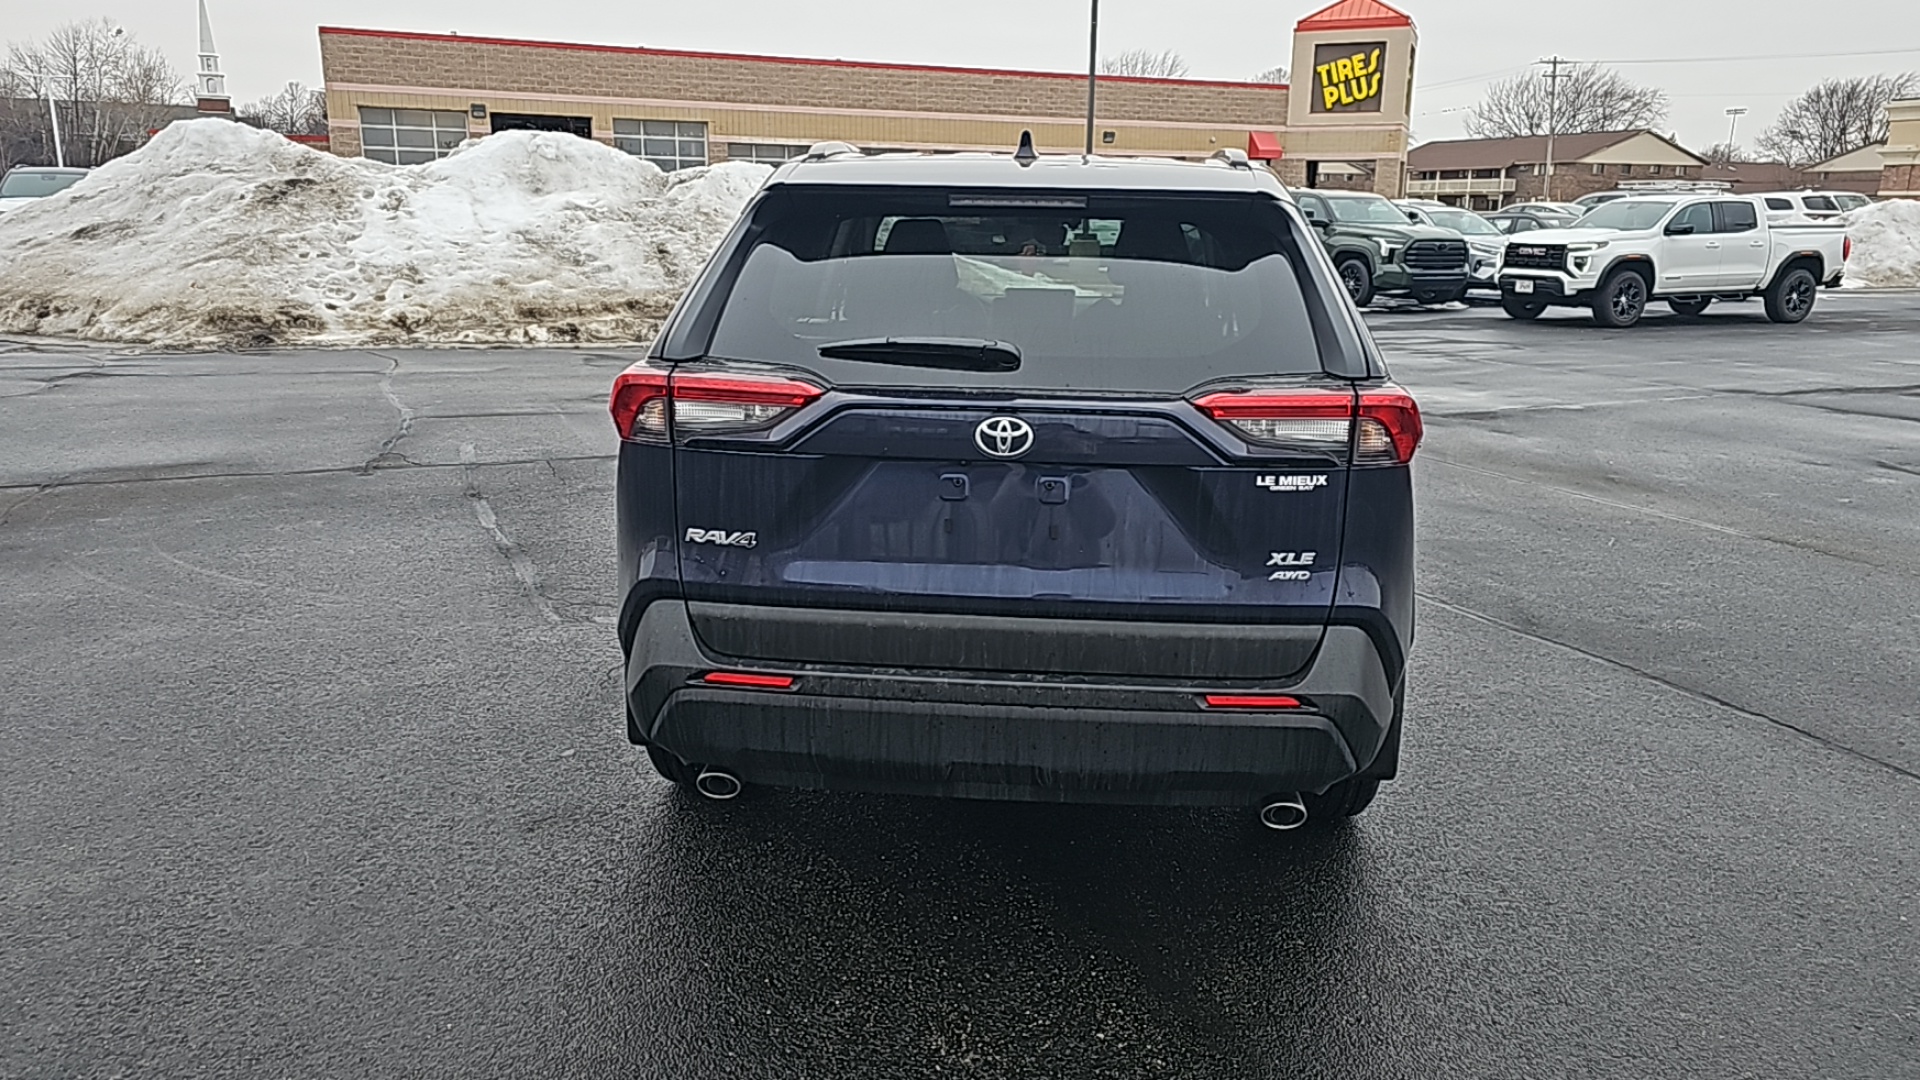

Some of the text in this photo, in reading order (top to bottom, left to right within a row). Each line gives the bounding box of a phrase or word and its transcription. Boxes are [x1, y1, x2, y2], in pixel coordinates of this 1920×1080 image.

[1316, 48, 1380, 87] TIRES
[1323, 71, 1381, 110] PLUS
[1256, 474, 1328, 486] LE MIEUX
[684, 527, 757, 549] RAV4
[1265, 552, 1317, 566] XLE
[1268, 570, 1311, 581] AWD
